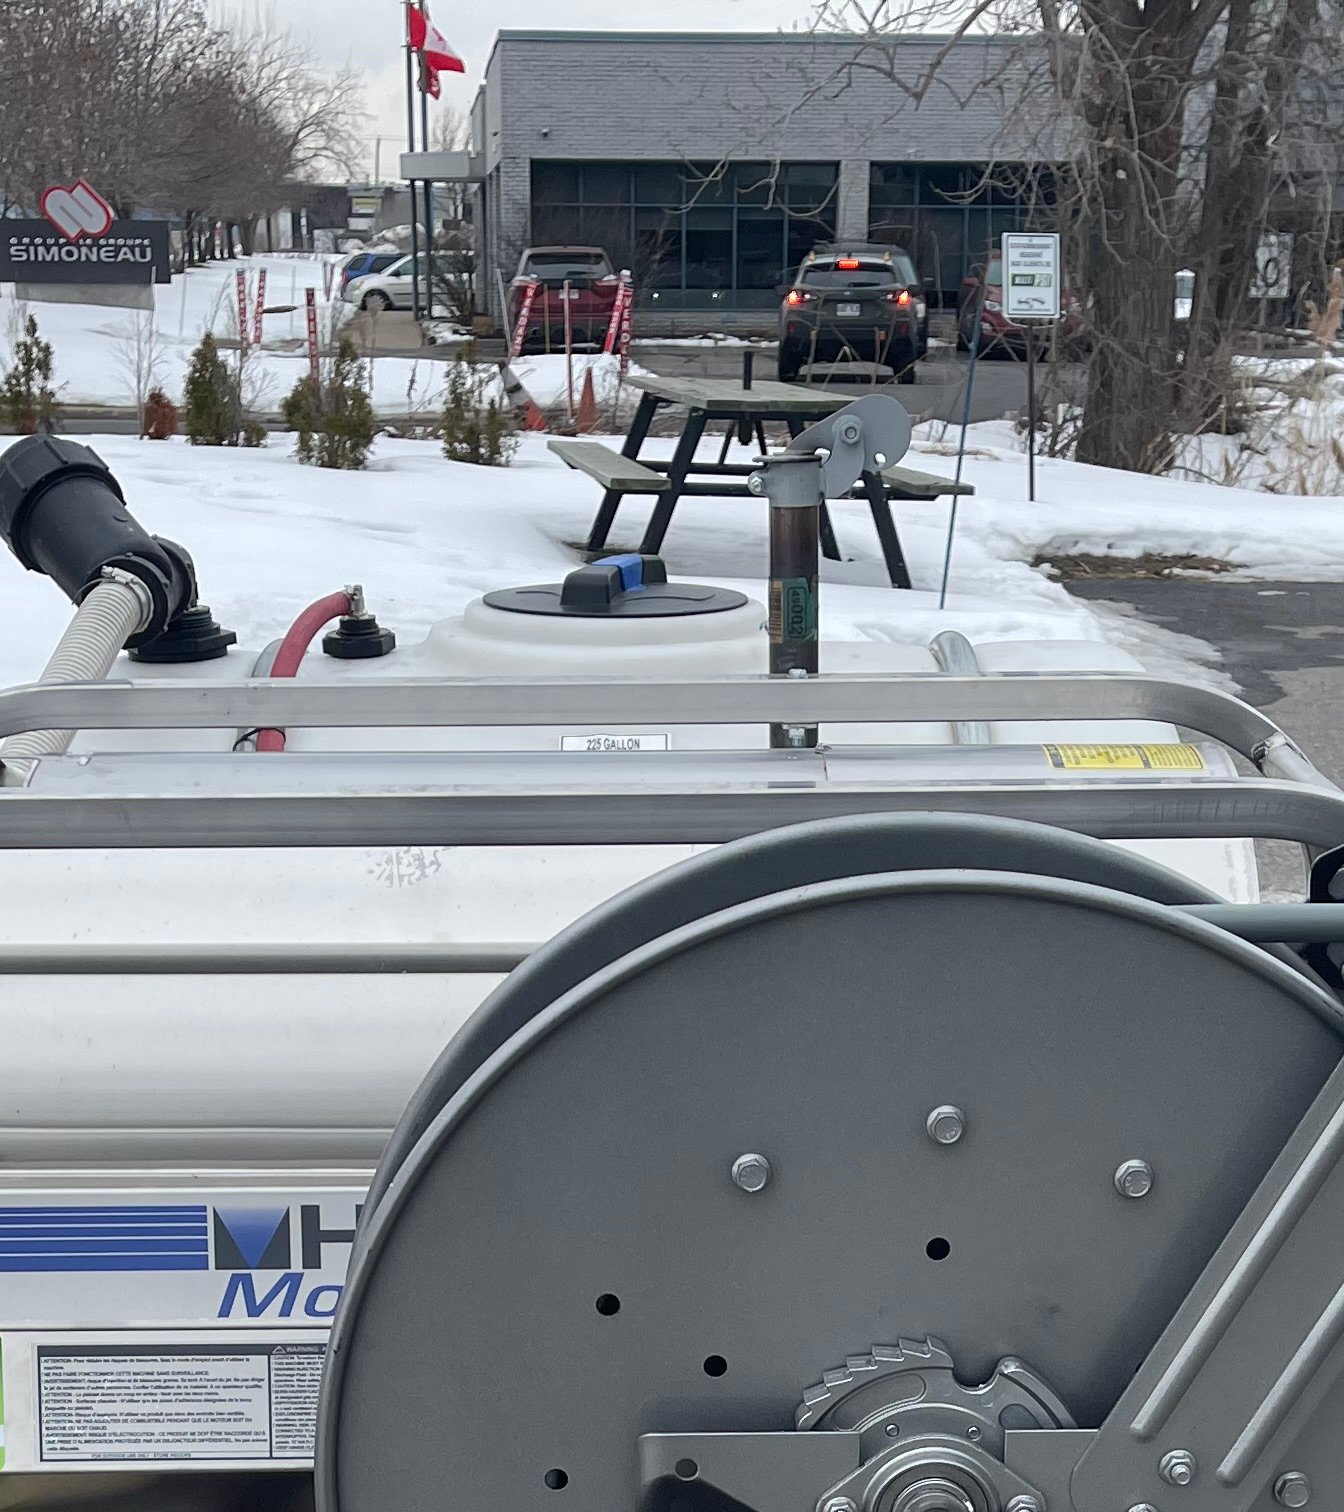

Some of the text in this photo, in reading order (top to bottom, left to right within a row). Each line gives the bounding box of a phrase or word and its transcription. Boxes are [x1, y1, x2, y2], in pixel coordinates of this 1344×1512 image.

[9, 246, 152, 262] SIMONEAU
[586, 738, 640, 750] 225 GALLON
